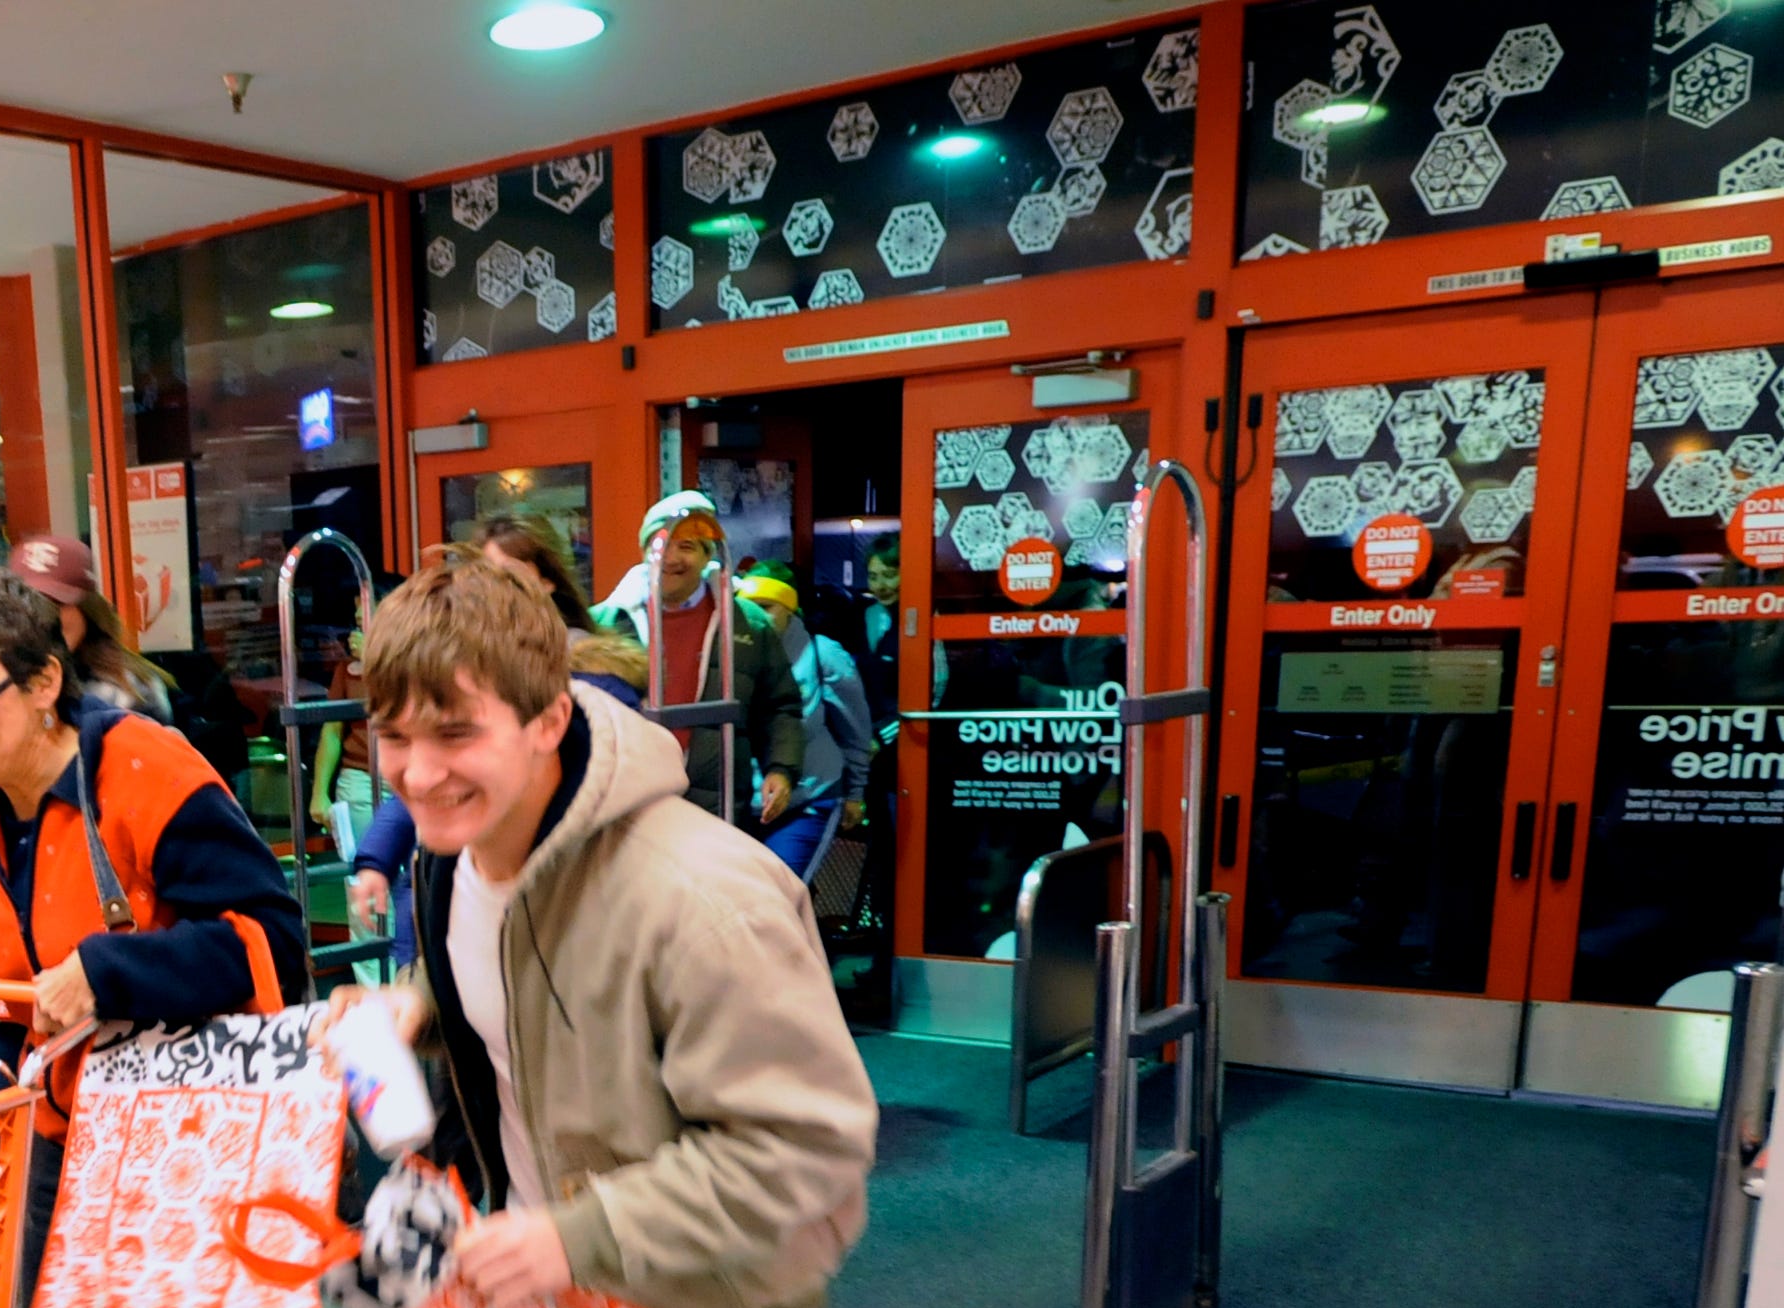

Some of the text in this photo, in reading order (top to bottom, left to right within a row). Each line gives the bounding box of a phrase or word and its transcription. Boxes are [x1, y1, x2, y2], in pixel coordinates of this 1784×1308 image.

[1459, 272, 1488, 287] DOOR
[1492, 270, 1507, 283] TO
[1665, 242, 1724, 262] BUSINESS
[1729, 237, 1770, 254] HOURS
[1744, 498, 1772, 513] DO
[1365, 525, 1420, 540] DO NOT
[1006, 550, 1055, 565] DO NOT
[1366, 554, 1416, 569] ENTER
[1008, 577, 1052, 592] ENTER
[1686, 593, 1753, 616] Enter
[989, 612, 1081, 636] Enter Only
[1330, 603, 1437, 630] Enter Only
